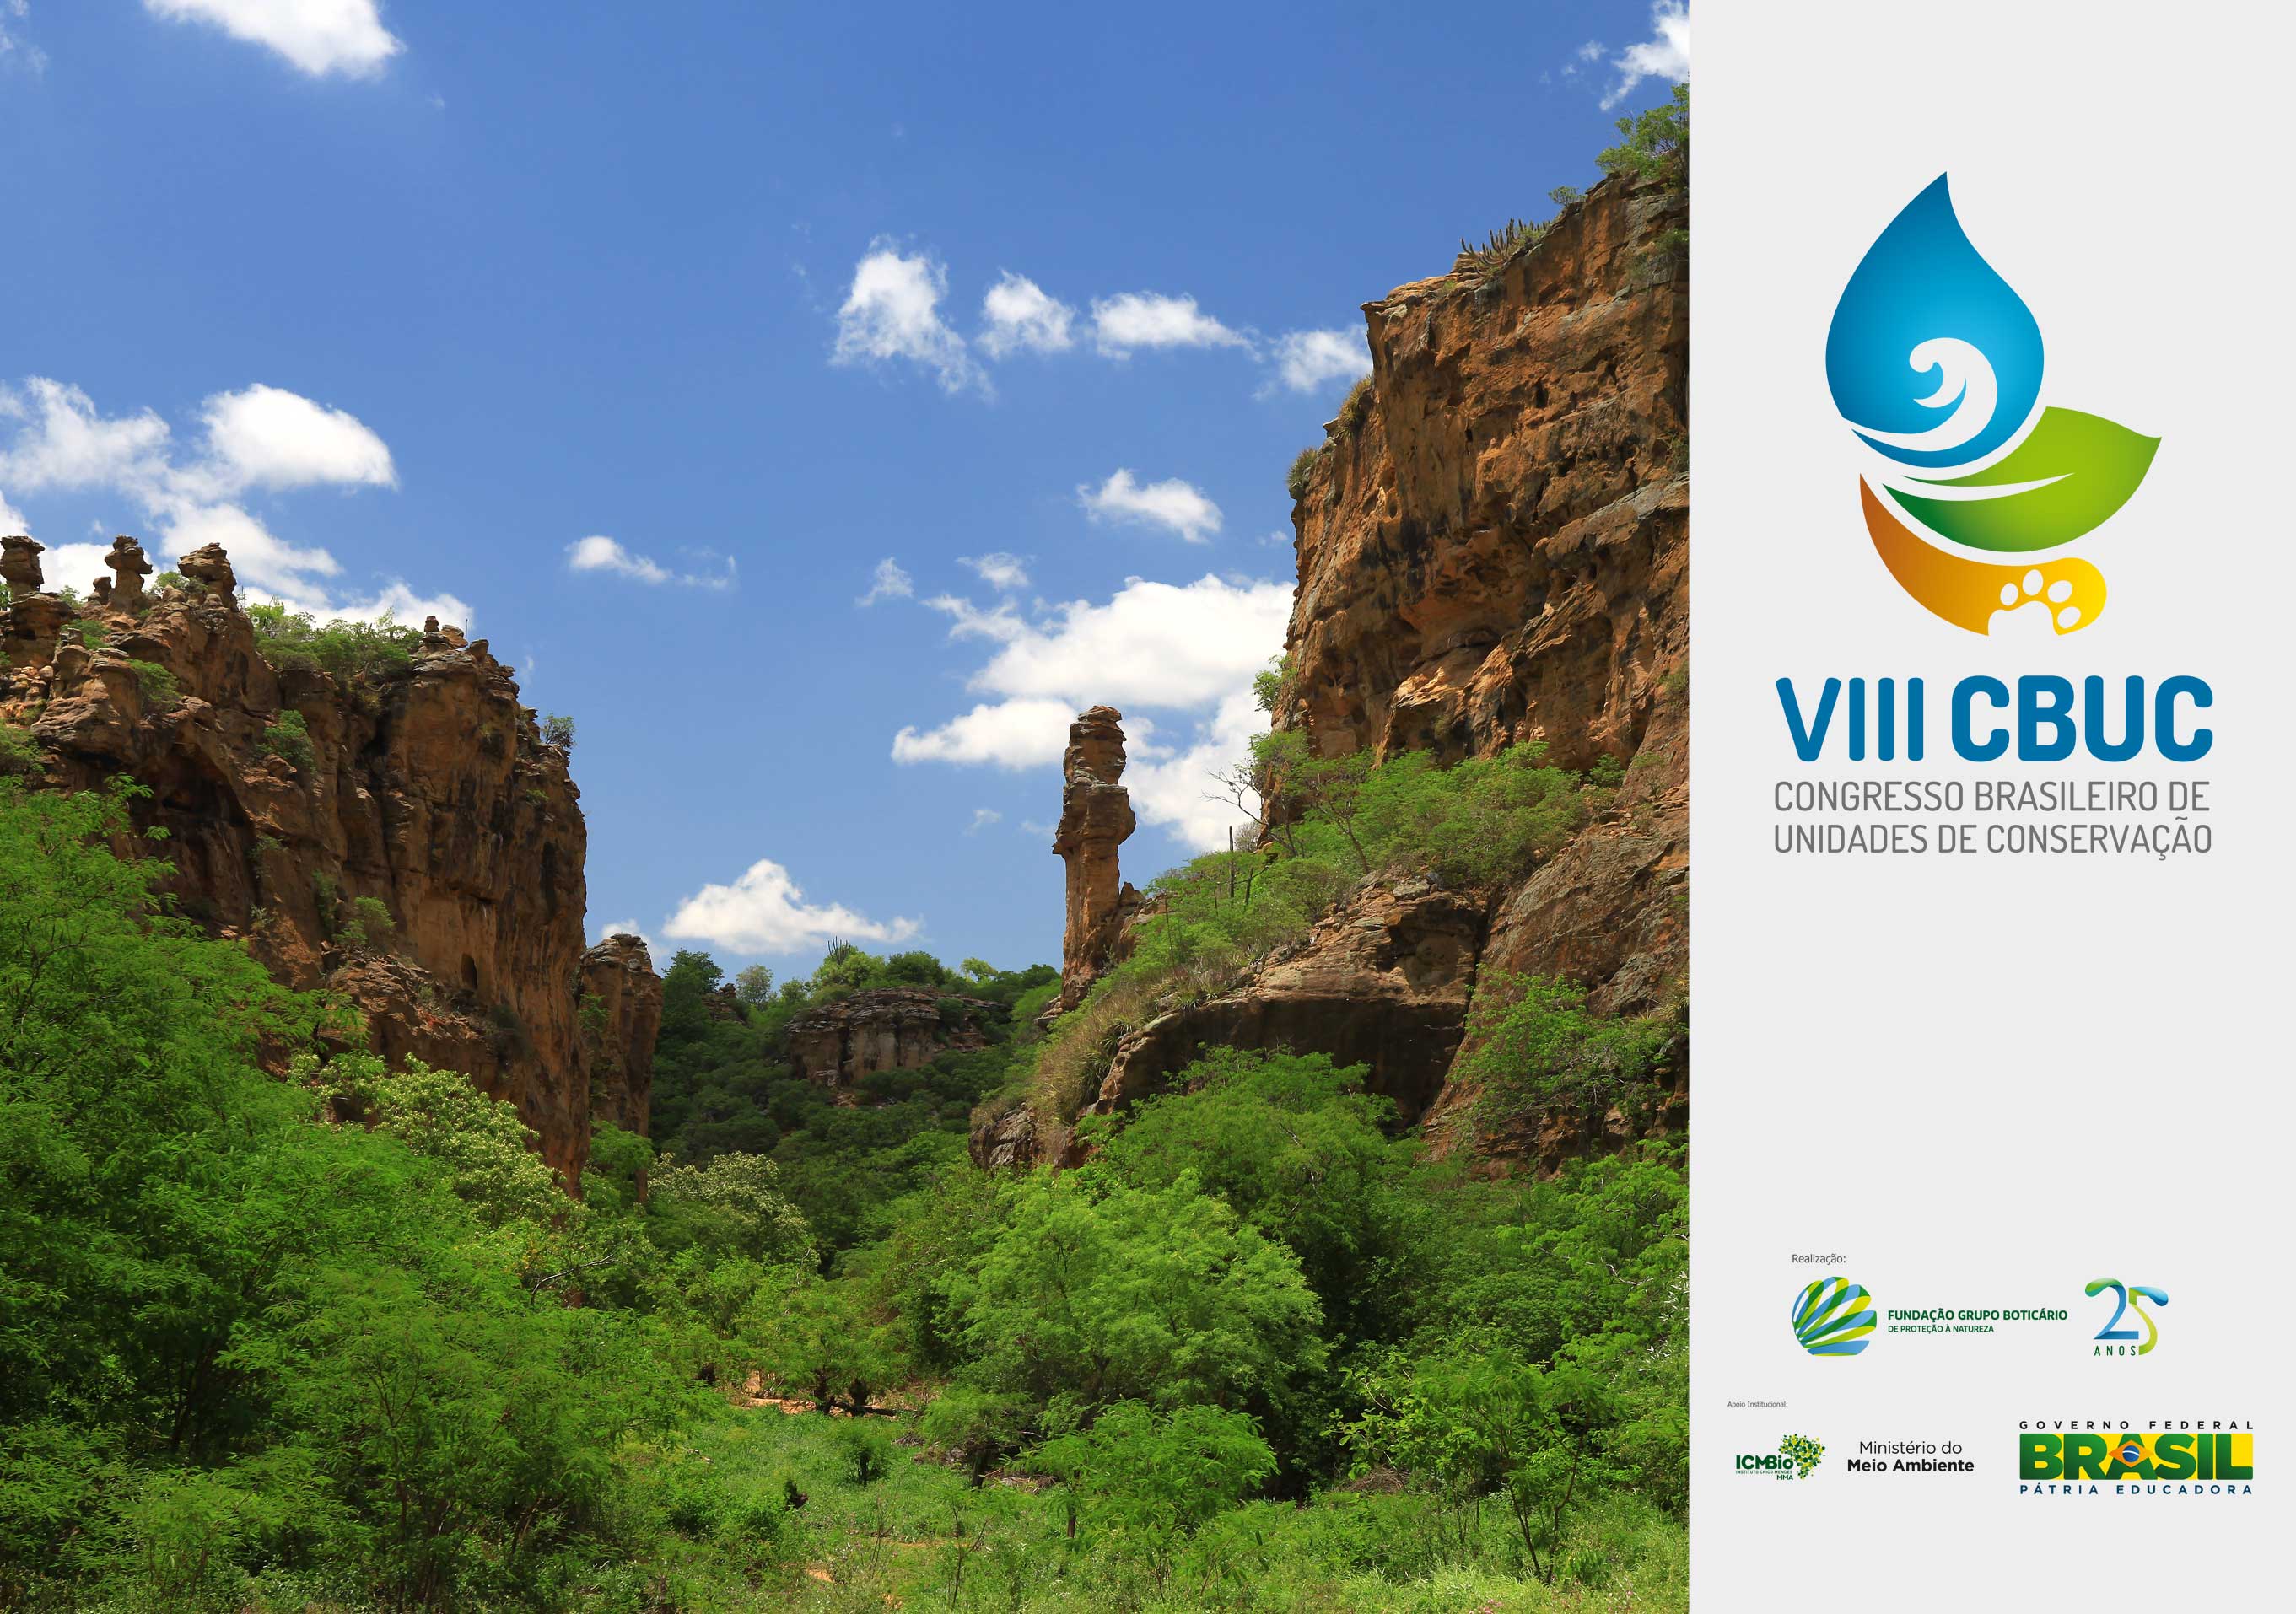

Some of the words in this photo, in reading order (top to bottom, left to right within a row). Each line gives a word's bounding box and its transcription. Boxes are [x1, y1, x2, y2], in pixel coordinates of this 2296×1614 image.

[1776, 677, 1924, 762] VIII
[1952, 675, 2213, 762] CBUC
[1776, 782, 1963, 811] CONGRESSO
[1976, 781, 2157, 811] BRASILEIRO
[2169, 782, 2209, 810] DE
[1775, 825, 1927, 853] UNIDADES
[1939, 825, 1977, 853] DE
[1988, 816, 2211, 860] CONSERVAÇÃO
[1792, 1254, 1846, 1265] Realização:
[1888, 1308, 1954, 1323] FUNDAÇÃO
[1958, 1310, 2000, 1321] GRUPO
[2003, 1308, 2067, 1321] BOTICÁRIO
[2085, 1278, 2169, 1356] 25
[1900, 1324, 1943, 1334] PROTEÇÃO
[1945, 1324, 1951, 1332] À
[2094, 1345, 2136, 1356] ANOS
[2019, 1421, 2129, 1429] GOVERNO
[2149, 1421, 2253, 1429] FEDERAL
[1860, 1441, 1936, 1454] Ministério
[1942, 1441, 1962, 1454] do
[1736, 1455, 1794, 1470] ICMBio
[2019, 1434, 2253, 1480] BRASIL
[1848, 1459, 1887, 1471] Meio
[1893, 1459, 1974, 1471] Ambiente
[2020, 1482, 2098, 1494] PÁTRIA
[2116, 1485, 2252, 1494] EDUCADORA
